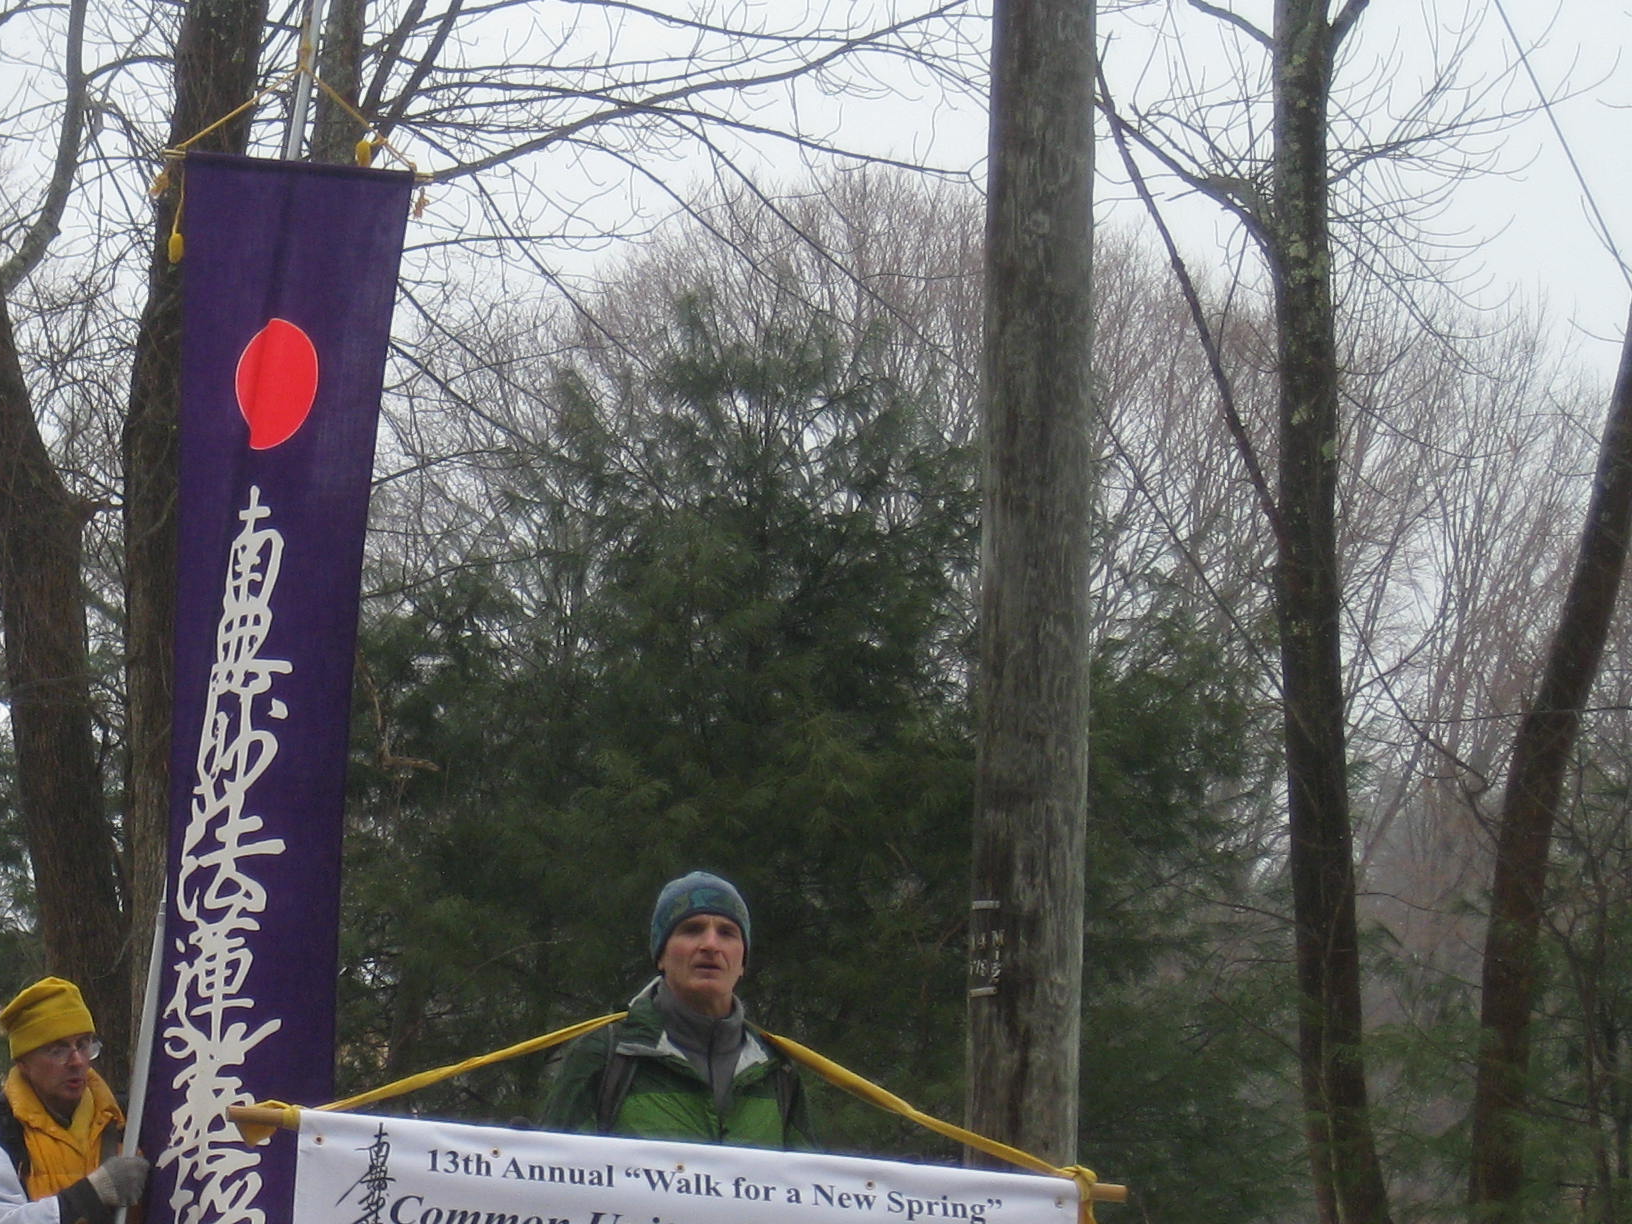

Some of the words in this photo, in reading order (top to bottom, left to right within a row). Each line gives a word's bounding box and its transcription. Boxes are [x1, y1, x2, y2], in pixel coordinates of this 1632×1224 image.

[427, 1148, 492, 1178] 13th
[502, 1157, 614, 1188] Annual
[624, 1166, 723, 1198] “Walk
[732, 1177, 777, 1202] for
[786, 1188, 802, 1205] a
[813, 1184, 878, 1211] New
